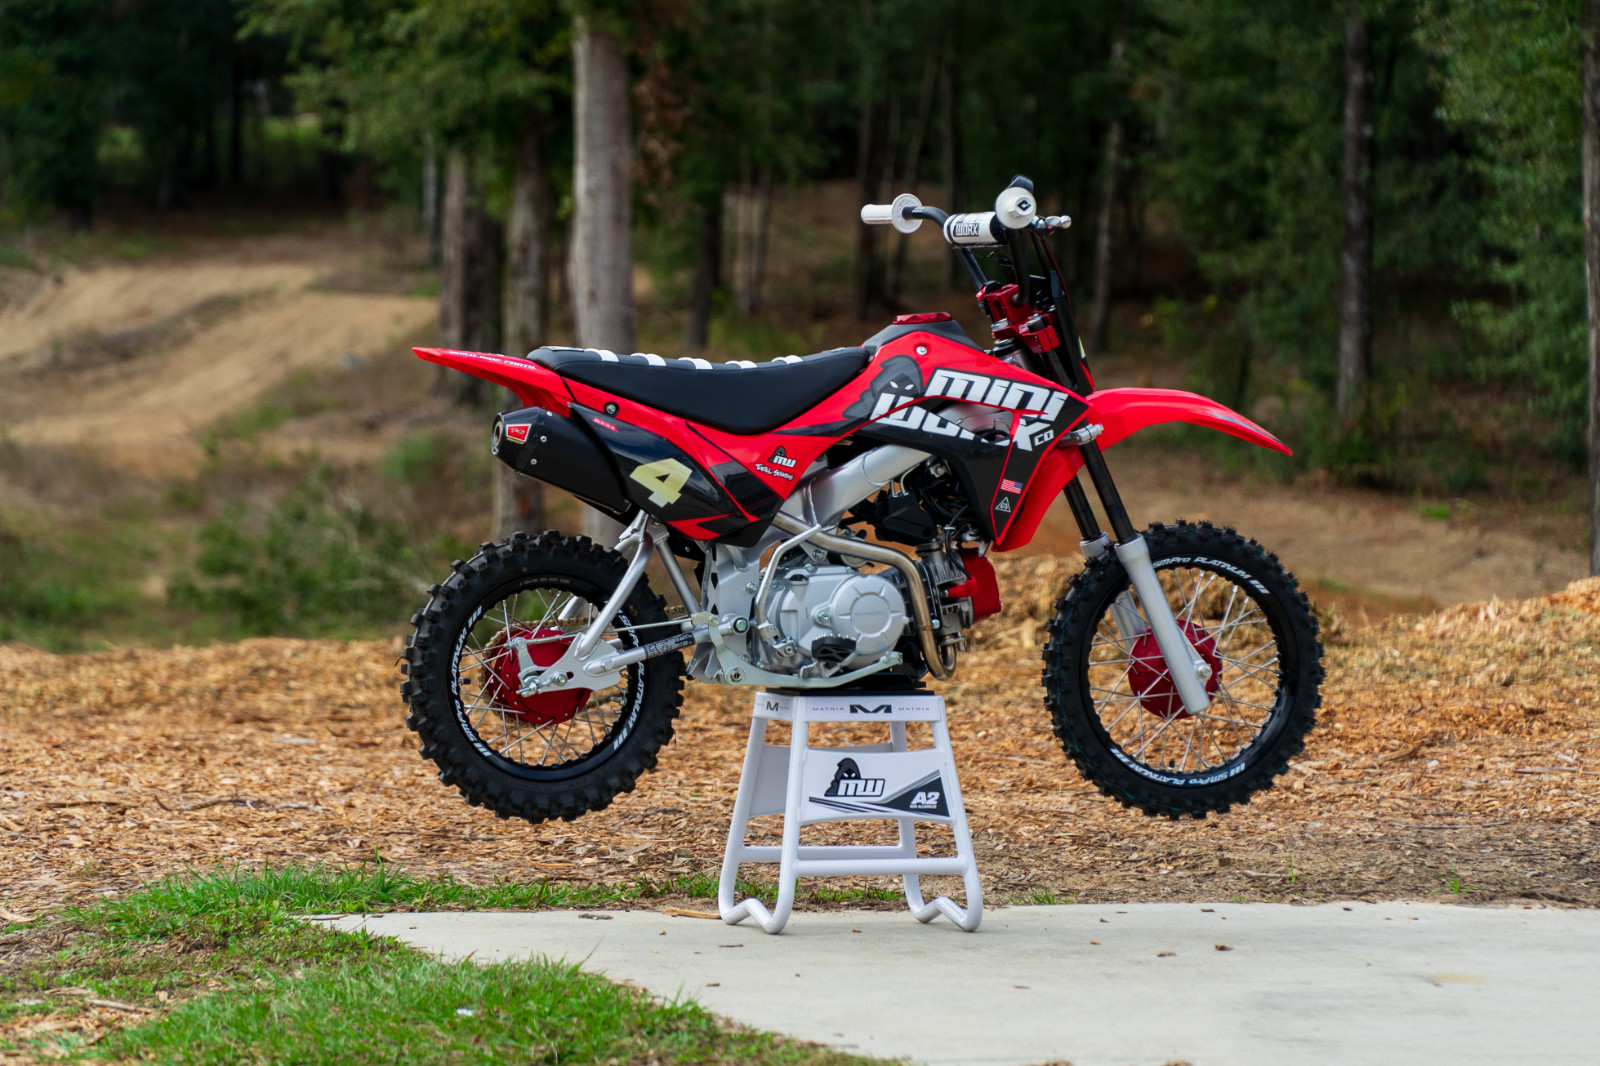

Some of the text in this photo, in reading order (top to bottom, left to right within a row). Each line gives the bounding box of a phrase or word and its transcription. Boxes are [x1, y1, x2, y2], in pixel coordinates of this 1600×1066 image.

[629, 458, 693, 508] 4
[1194, 556, 1253, 580] PLATINUM
[451, 626, 468, 696] PLATINUM
[627, 660, 645, 729] PLATINUM
[1128, 763, 1186, 786] PLATINUM
[910, 791, 941, 805] A2
